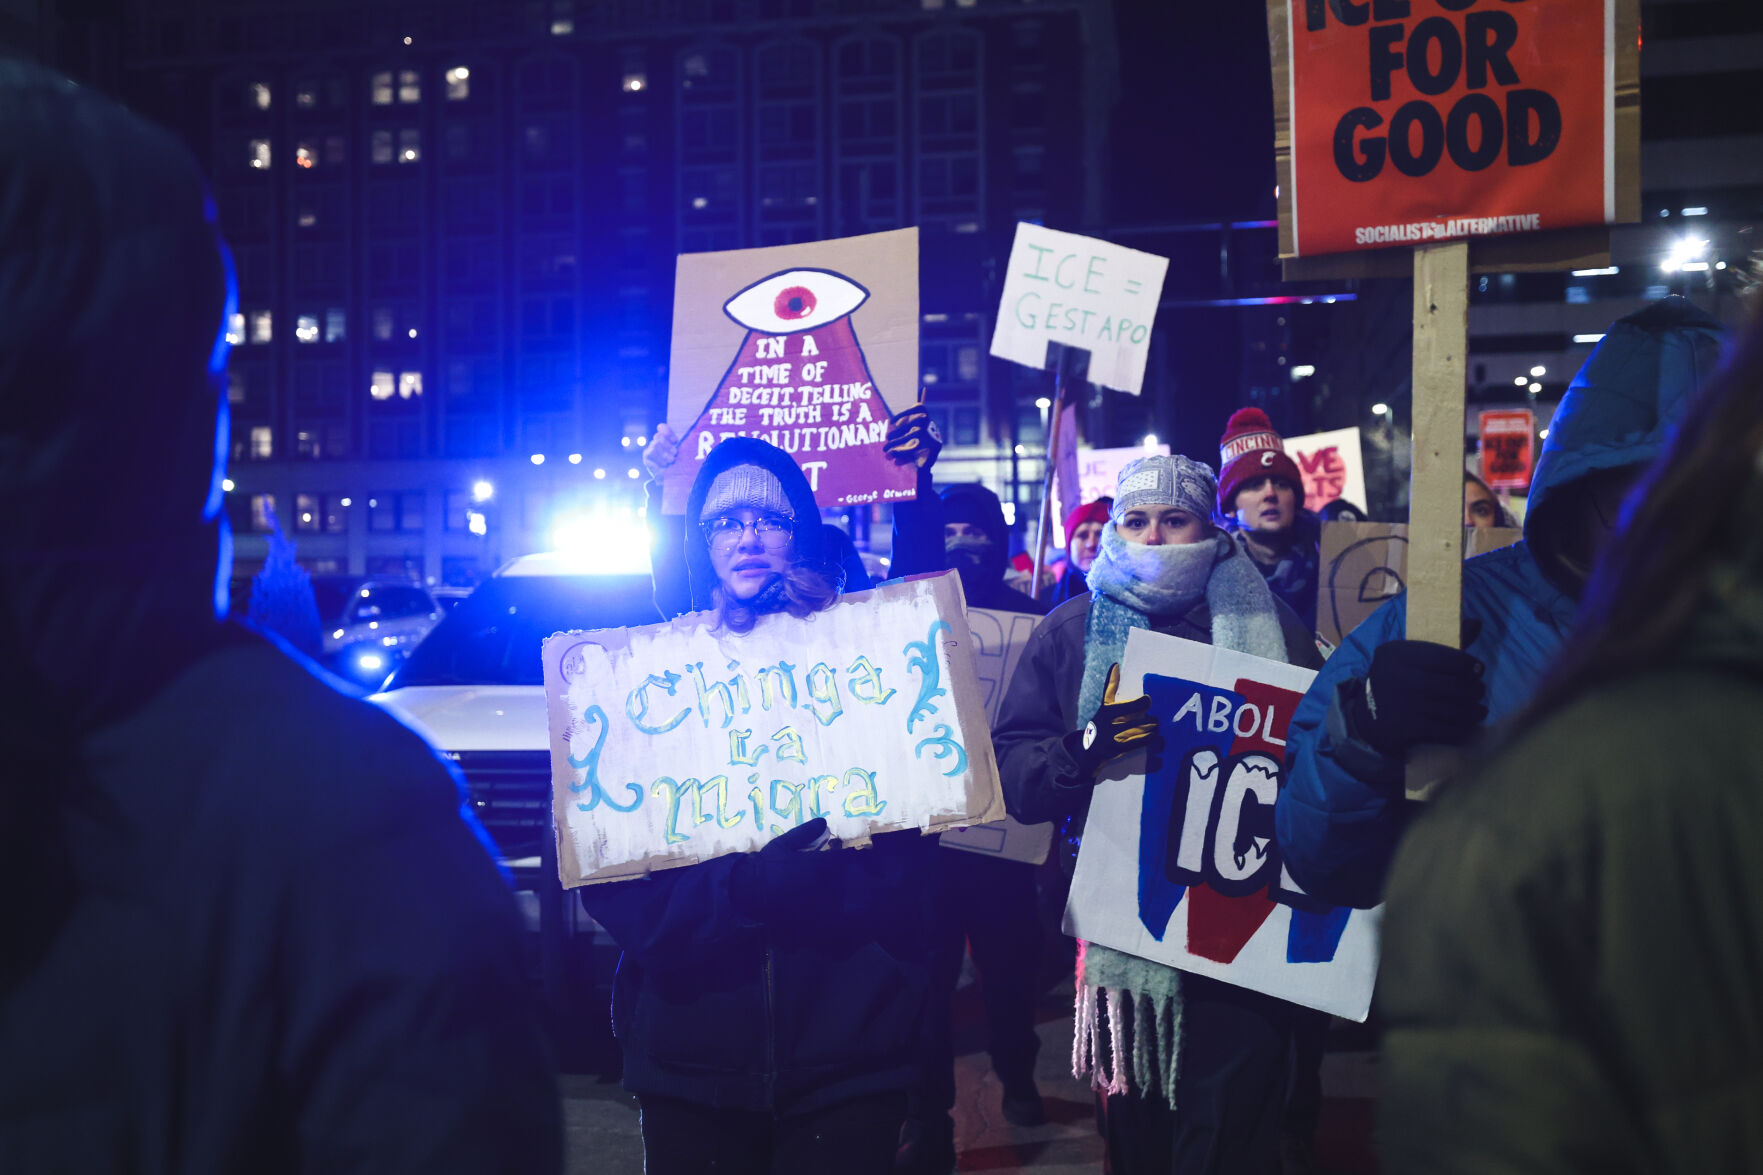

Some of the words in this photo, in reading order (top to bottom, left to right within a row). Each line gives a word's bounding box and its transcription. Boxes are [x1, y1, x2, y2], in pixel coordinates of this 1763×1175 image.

[1369, 10, 1520, 102] FOR
[1333, 88, 1562, 182] GOOD
[1355, 223, 1429, 244] SOCIALIST
[1445, 213, 1540, 238] ALTERNATIVE
[1023, 242, 1107, 294] ICE
[1016, 291, 1148, 344] GESTAPO
[755, 335, 786, 359] IN
[801, 335, 819, 357] A
[738, 362, 792, 384] TIME
[802, 361, 828, 382] OF
[799, 382, 872, 404] TELLING
[709, 407, 746, 425] THE
[759, 405, 821, 426] TRUTH
[832, 403, 851, 422] IS
[856, 402, 873, 422] A
[1297, 446, 1344, 474] VE
[626, 656, 896, 735] Chinga
[1173, 692, 1286, 746] ABOL
